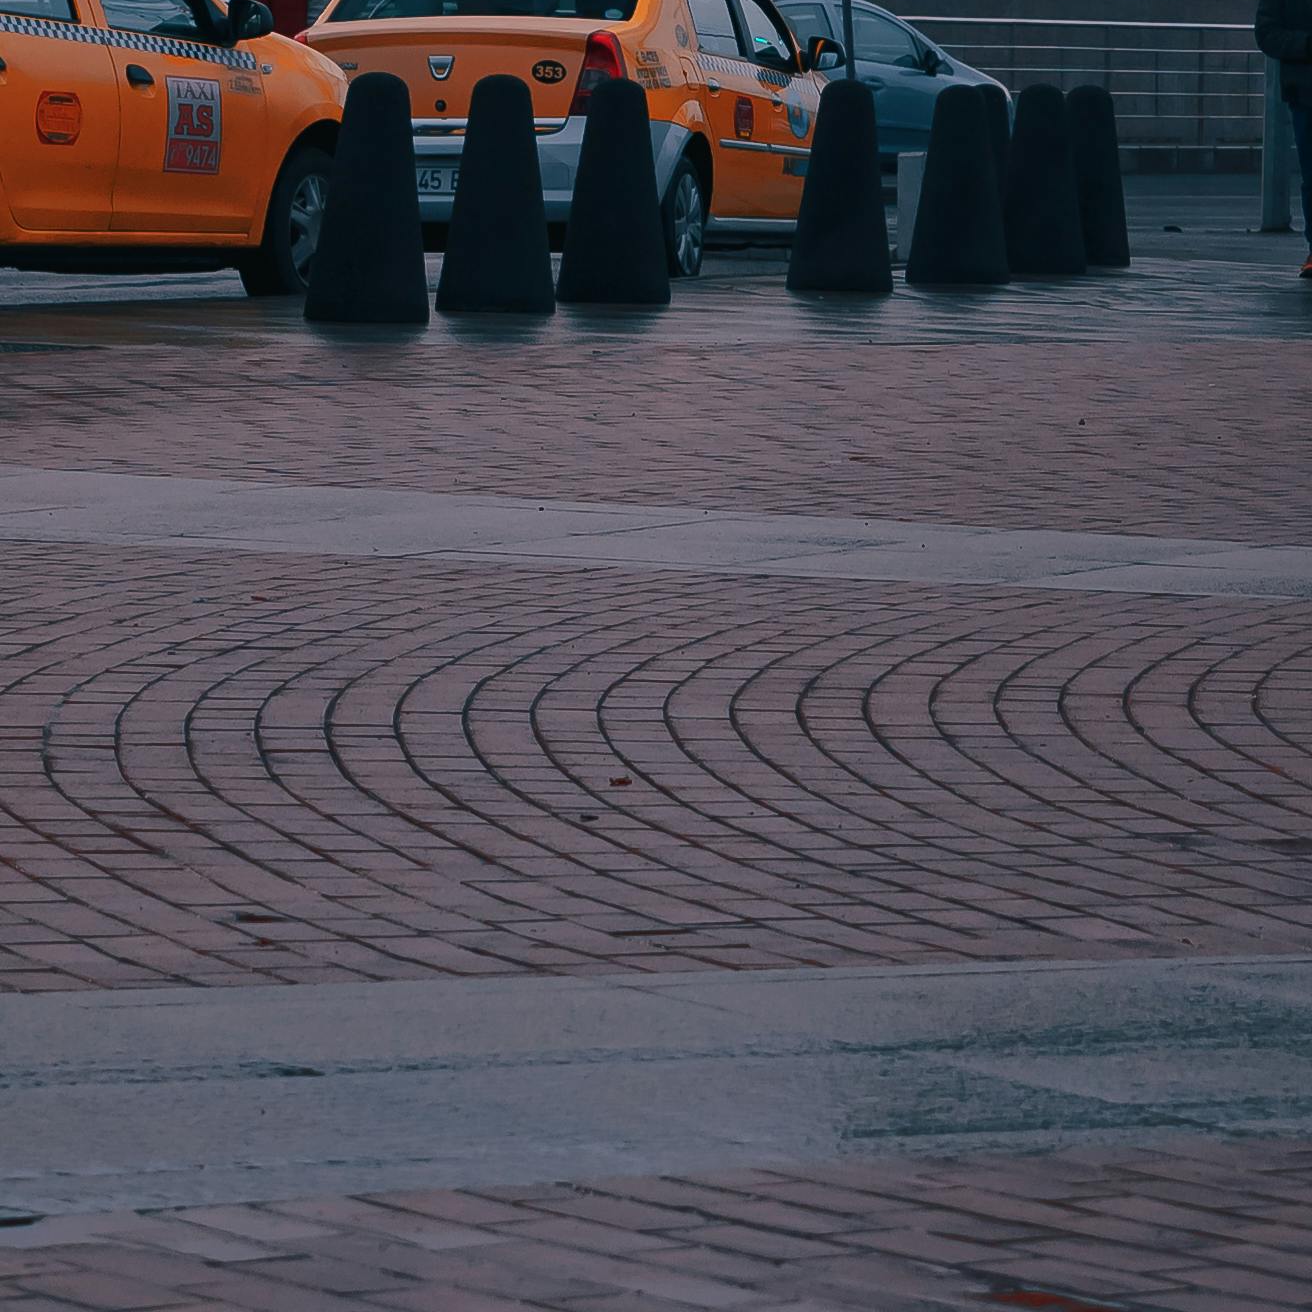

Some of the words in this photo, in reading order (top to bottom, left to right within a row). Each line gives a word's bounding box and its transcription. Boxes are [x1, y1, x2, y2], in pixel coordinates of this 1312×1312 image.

[534, 65, 564, 79] 353
[174, 80, 217, 101] TAXI
[174, 103, 215, 137] AS
[185, 144, 217, 169] 9474
[419, 170, 442, 190] 45
